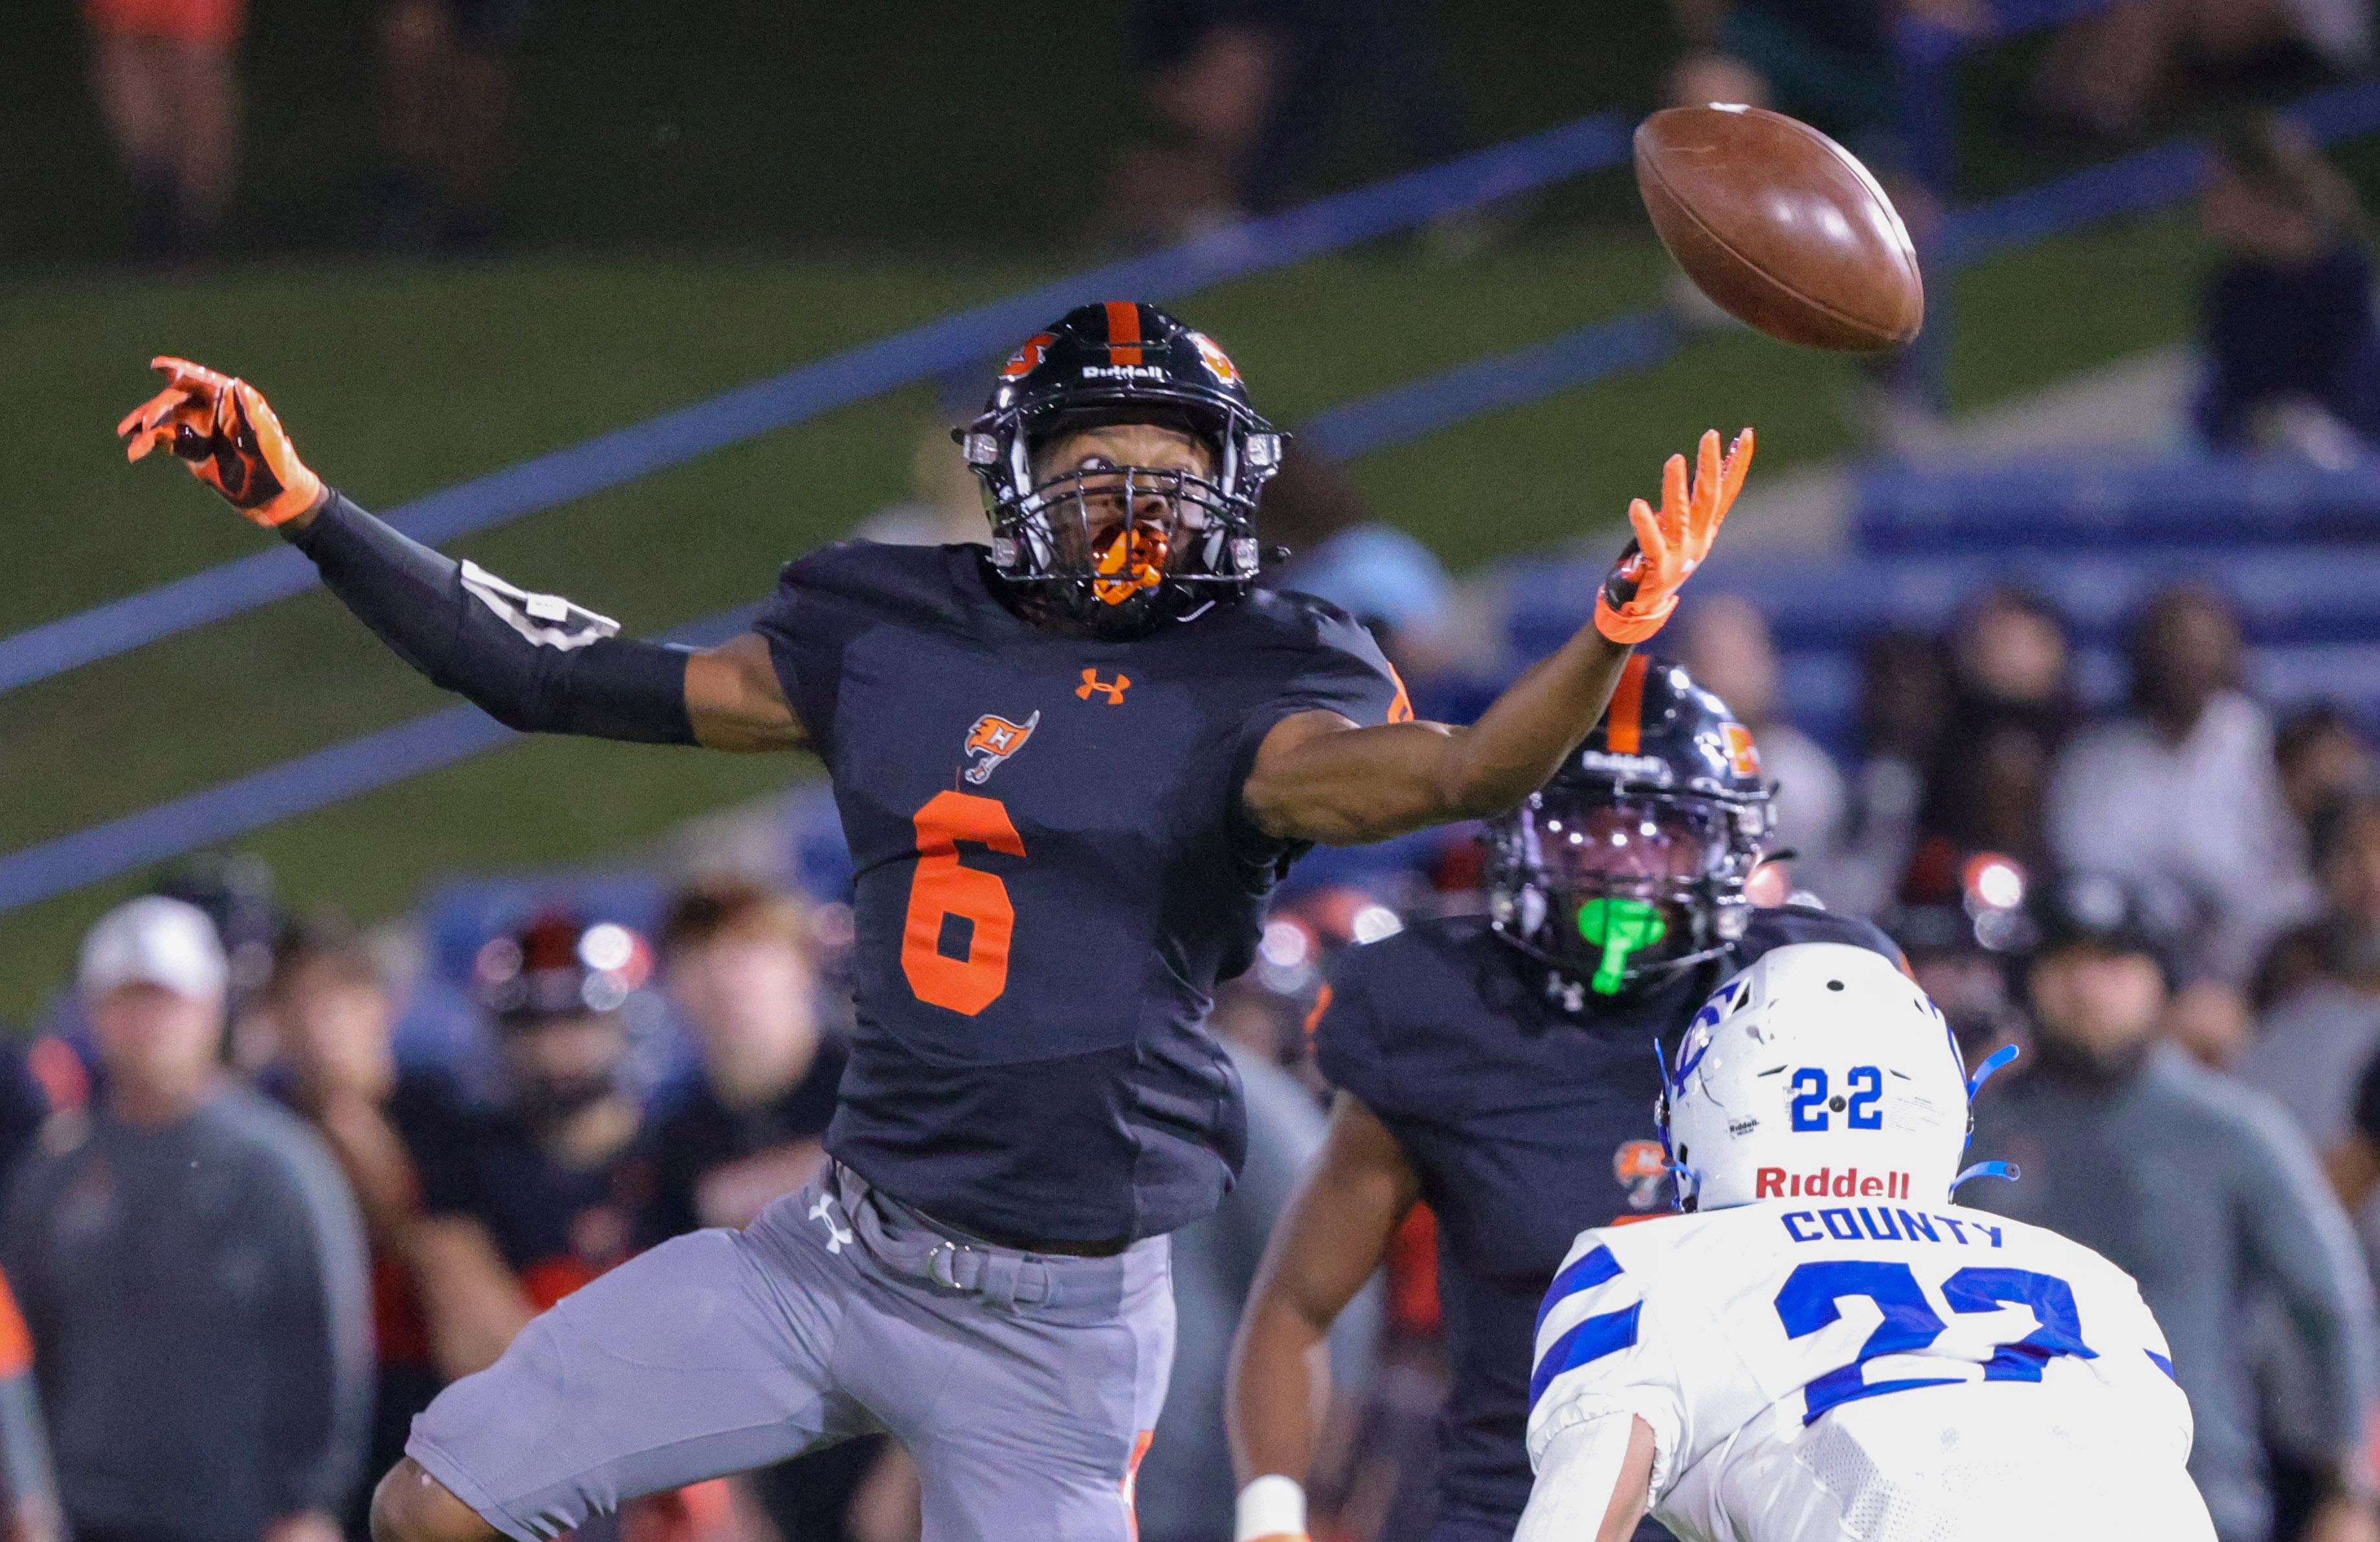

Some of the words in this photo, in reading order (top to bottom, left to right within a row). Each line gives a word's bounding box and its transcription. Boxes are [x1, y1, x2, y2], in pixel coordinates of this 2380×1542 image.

[900, 790, 1027, 1017] 6
[1792, 1066, 1883, 1132] 22
[1756, 1167, 1909, 1200] Riddell
[1781, 1207, 2002, 1248] COUNTY
[1774, 1260, 2100, 1427] 22
